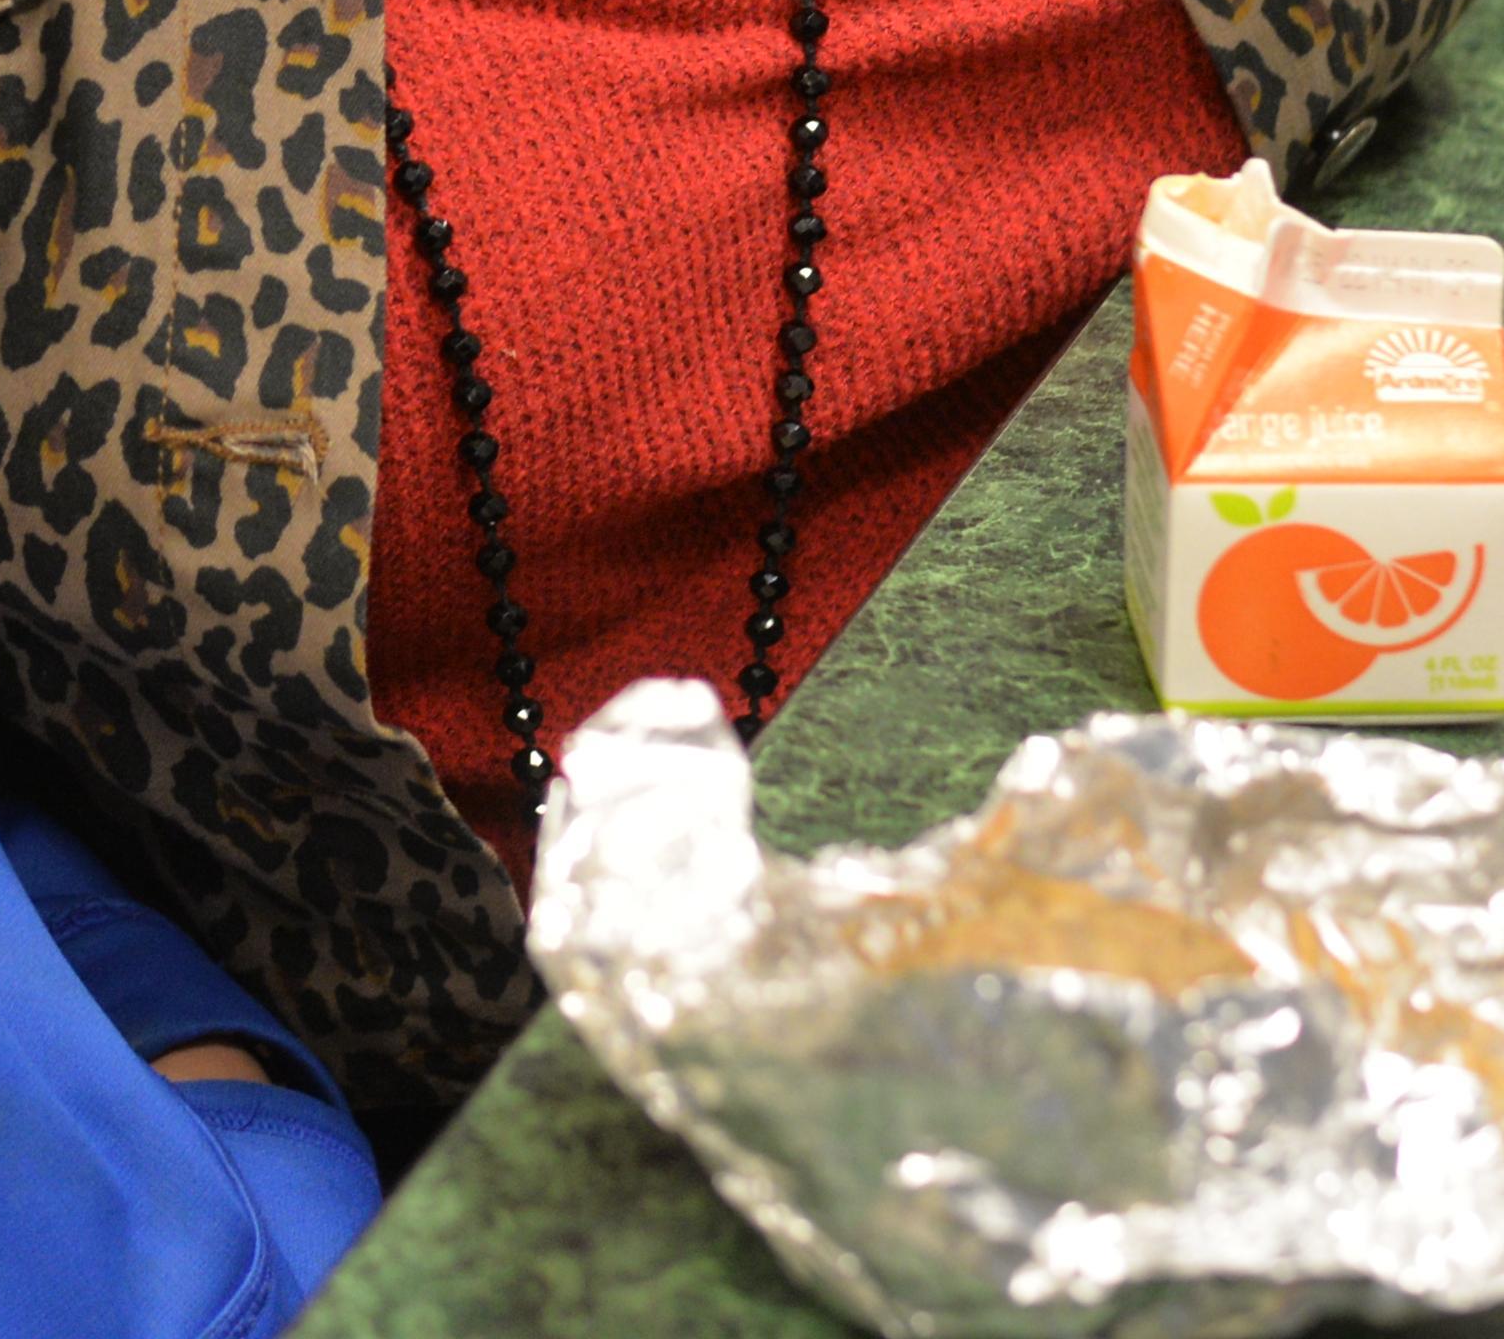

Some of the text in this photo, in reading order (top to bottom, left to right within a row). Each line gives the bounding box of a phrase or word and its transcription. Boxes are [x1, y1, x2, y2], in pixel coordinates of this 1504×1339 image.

[1307, 405, 1387, 449] juice
[1423, 654, 1498, 673] 4 FL OZ
